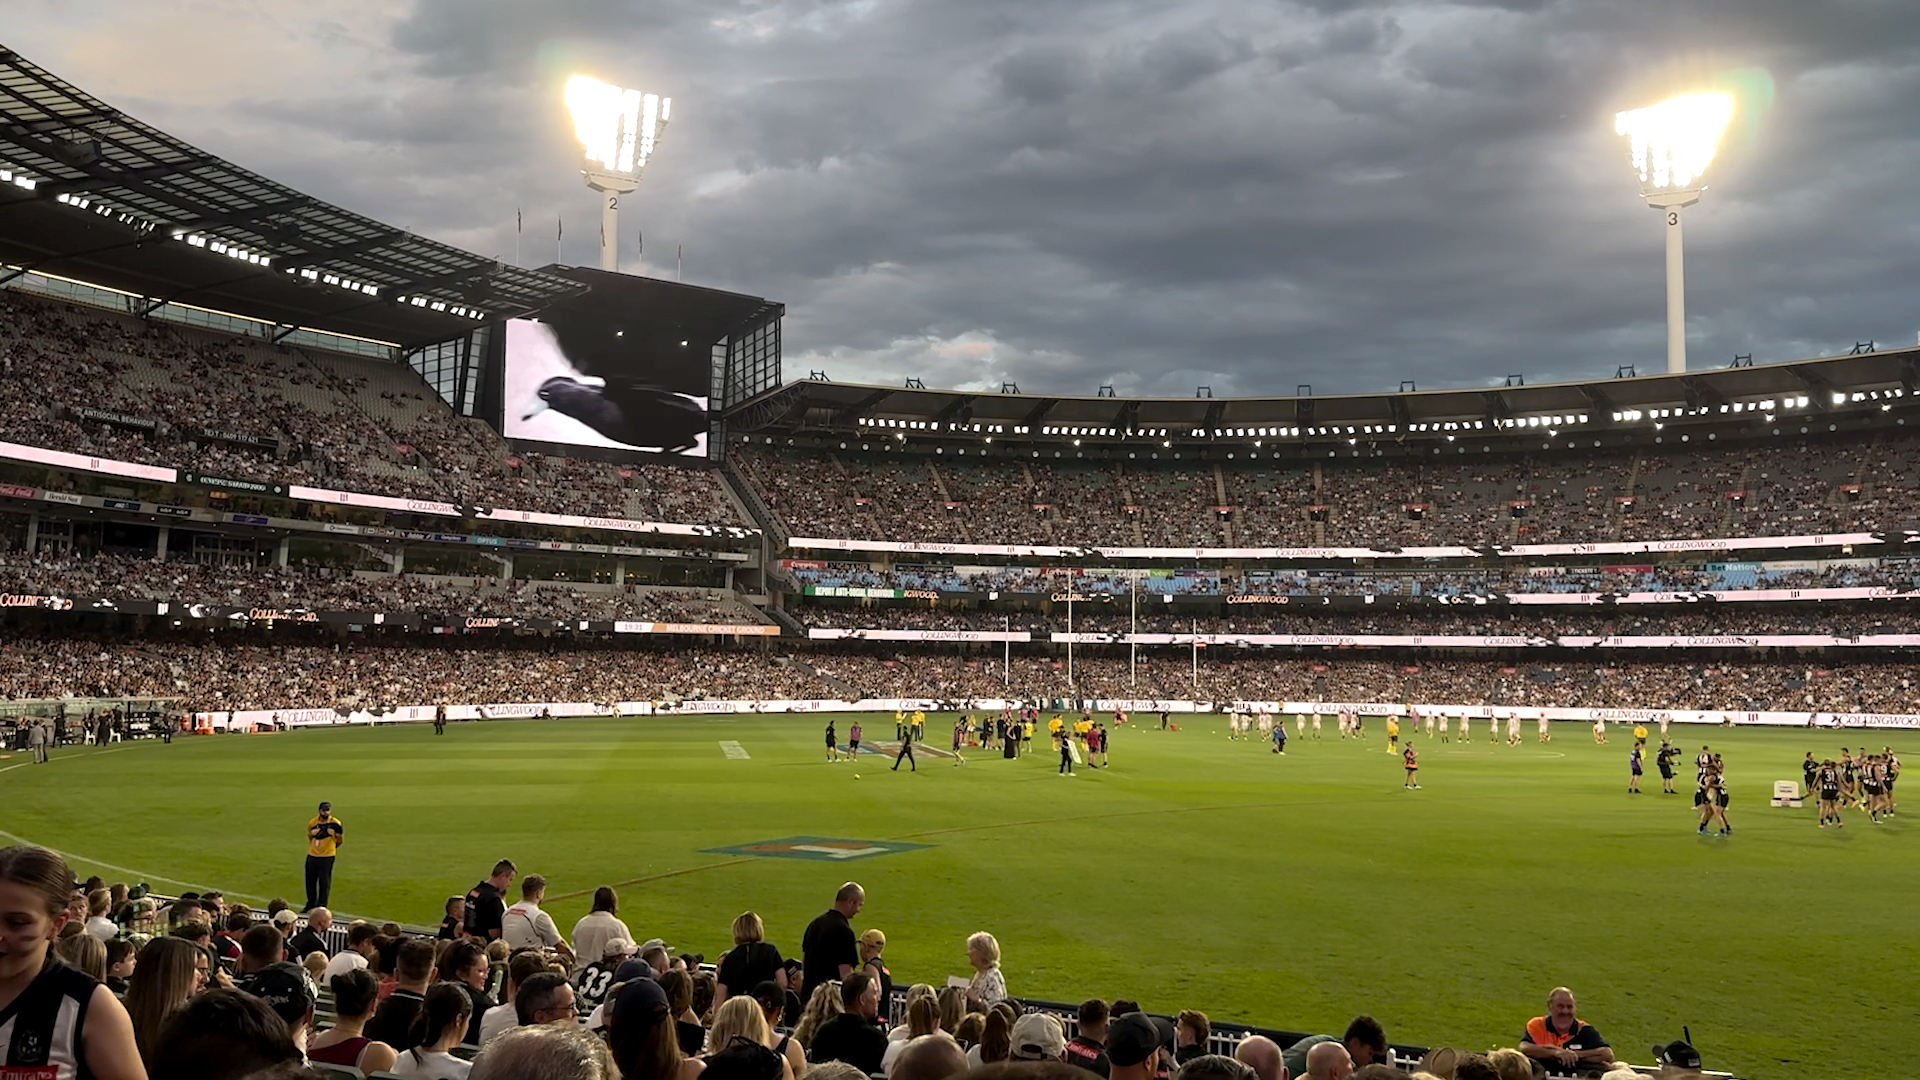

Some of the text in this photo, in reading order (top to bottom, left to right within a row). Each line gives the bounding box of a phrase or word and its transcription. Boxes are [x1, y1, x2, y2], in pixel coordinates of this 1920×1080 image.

[609, 197, 618, 210] 2
[1668, 212, 1678, 225] 3
[83, 408, 156, 428] ANTISOCIAL BEHAVIOUR
[407, 501, 456, 514] COLLINGWO
[583, 518, 641, 530] COLLINGWOOD
[899, 543, 956, 552] COLNGWOOD
[1658, 541, 1727, 550] COLLINGWOOD
[1275, 548, 1337, 557] COLLINGWOOD
[1226, 594, 1289, 604] COLLINGWOOD
[736, 626, 765, 634] GROUND
[921, 631, 978, 640] COLLINGWOOD
[1291, 634, 1354, 644] COLLINGWOOD
[1483, 635, 1524, 645] COLLING
[1687, 636, 1758, 645] COLLINGWOOD
[1312, 702, 1388, 714] COLLINGWOOD
[1589, 710, 1671, 721] COLLINGWOOD
[1839, 715, 1920, 726] COLLINGWOO
[1825, 771, 1835, 782] 31
[578, 966, 614, 998] 33
[0, 1070, 54, 1080] Emirates
